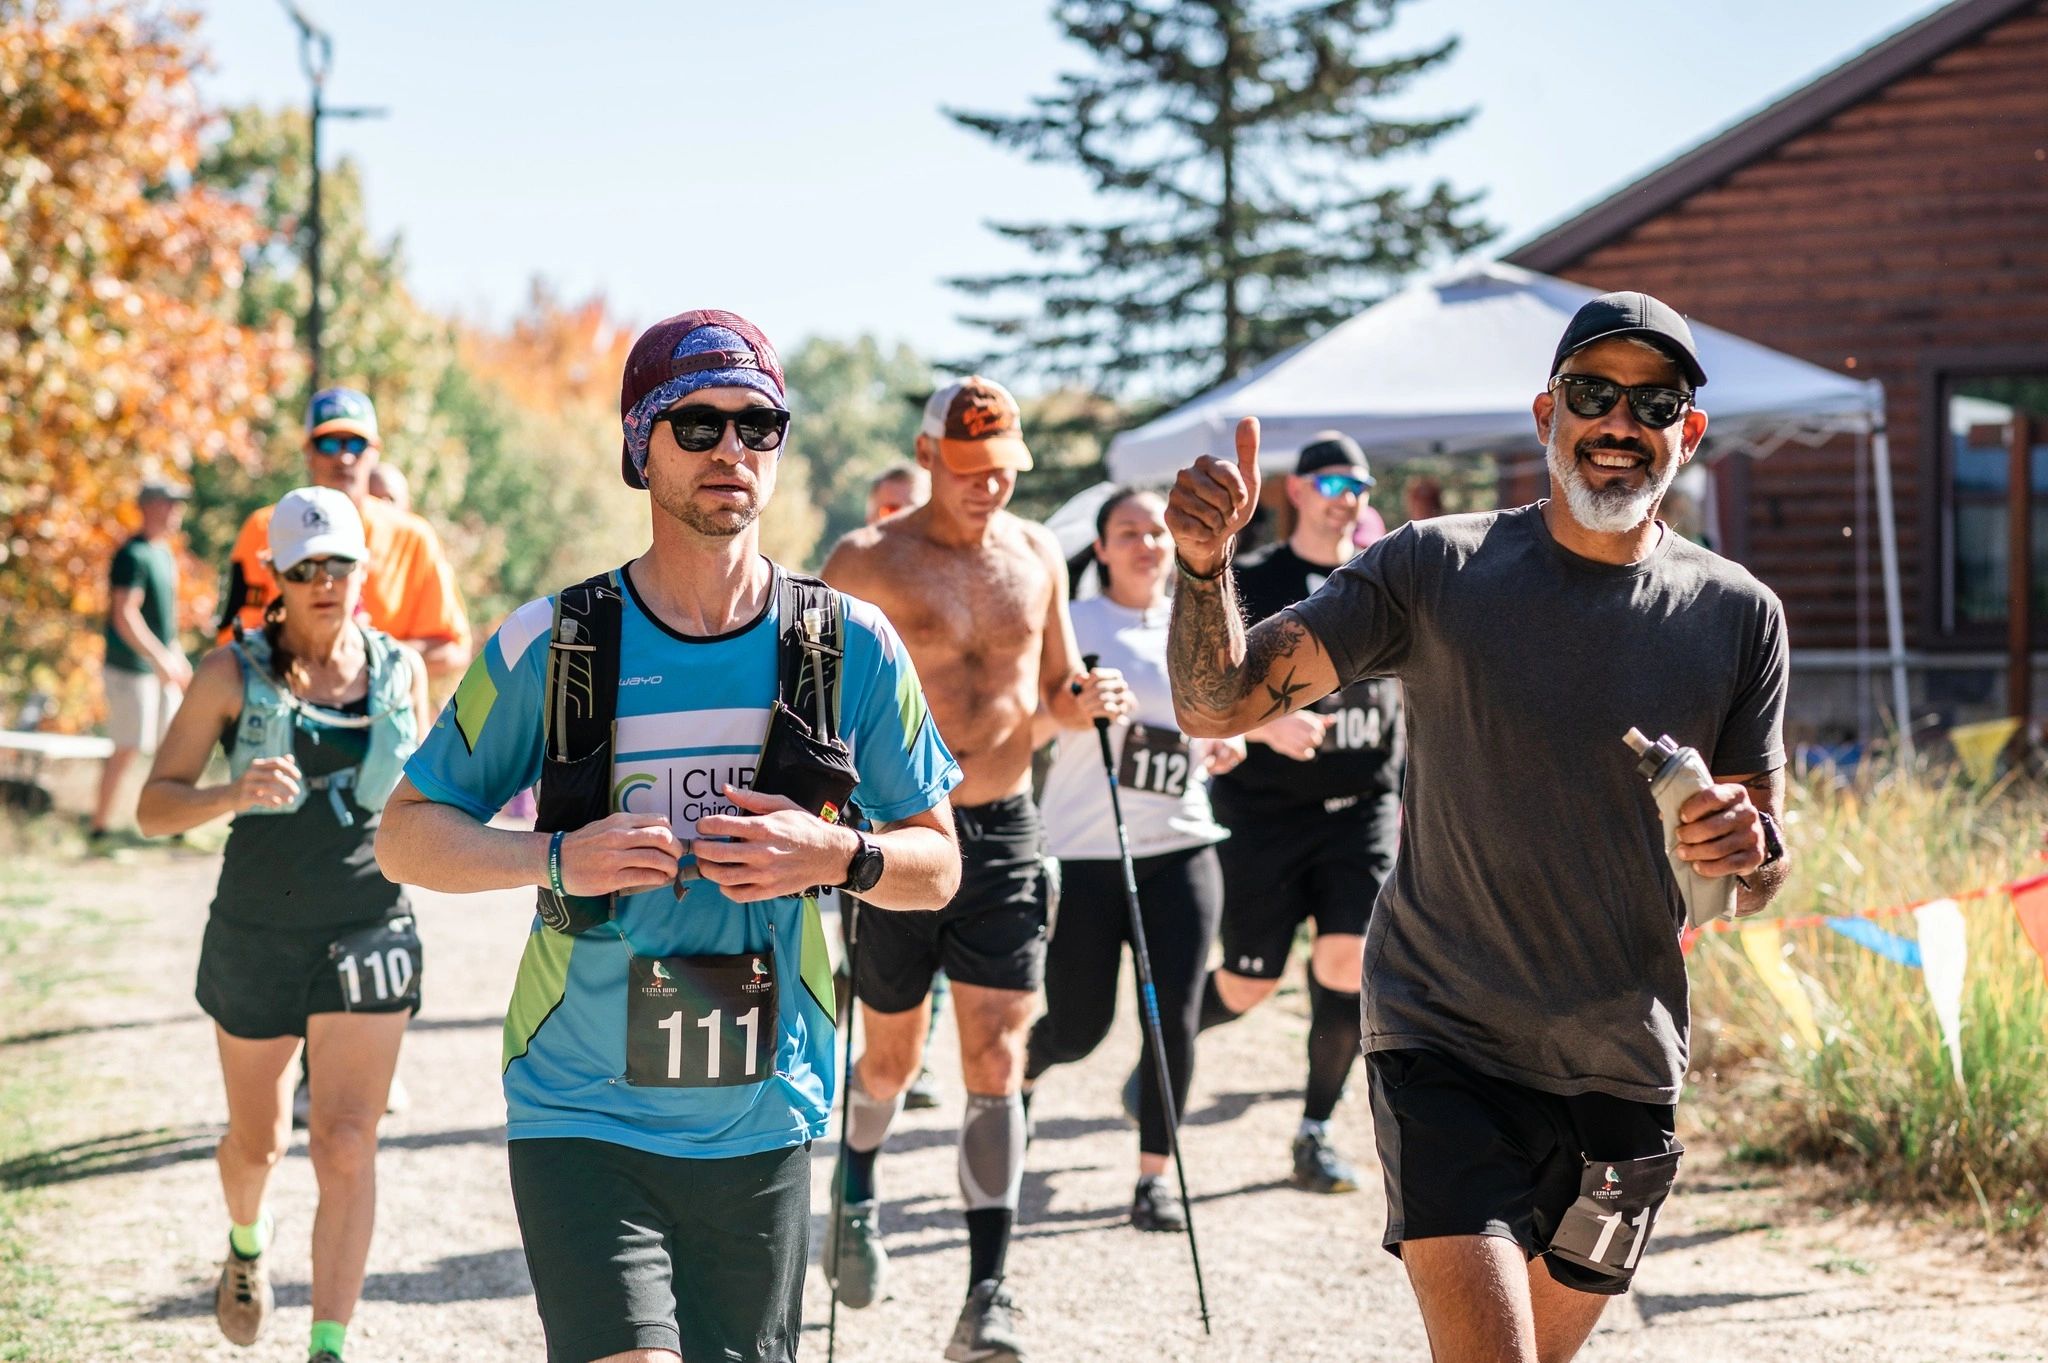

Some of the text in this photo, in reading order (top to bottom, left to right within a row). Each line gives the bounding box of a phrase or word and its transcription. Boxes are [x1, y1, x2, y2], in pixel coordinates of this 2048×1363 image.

[1336, 707, 1380, 749] 104
[1133, 748, 1187, 794] 112
[683, 802, 742, 822] Chiro
[337, 947, 413, 1003] 110
[658, 1007, 759, 1078] 111
[1588, 1206, 1664, 1269] 11
